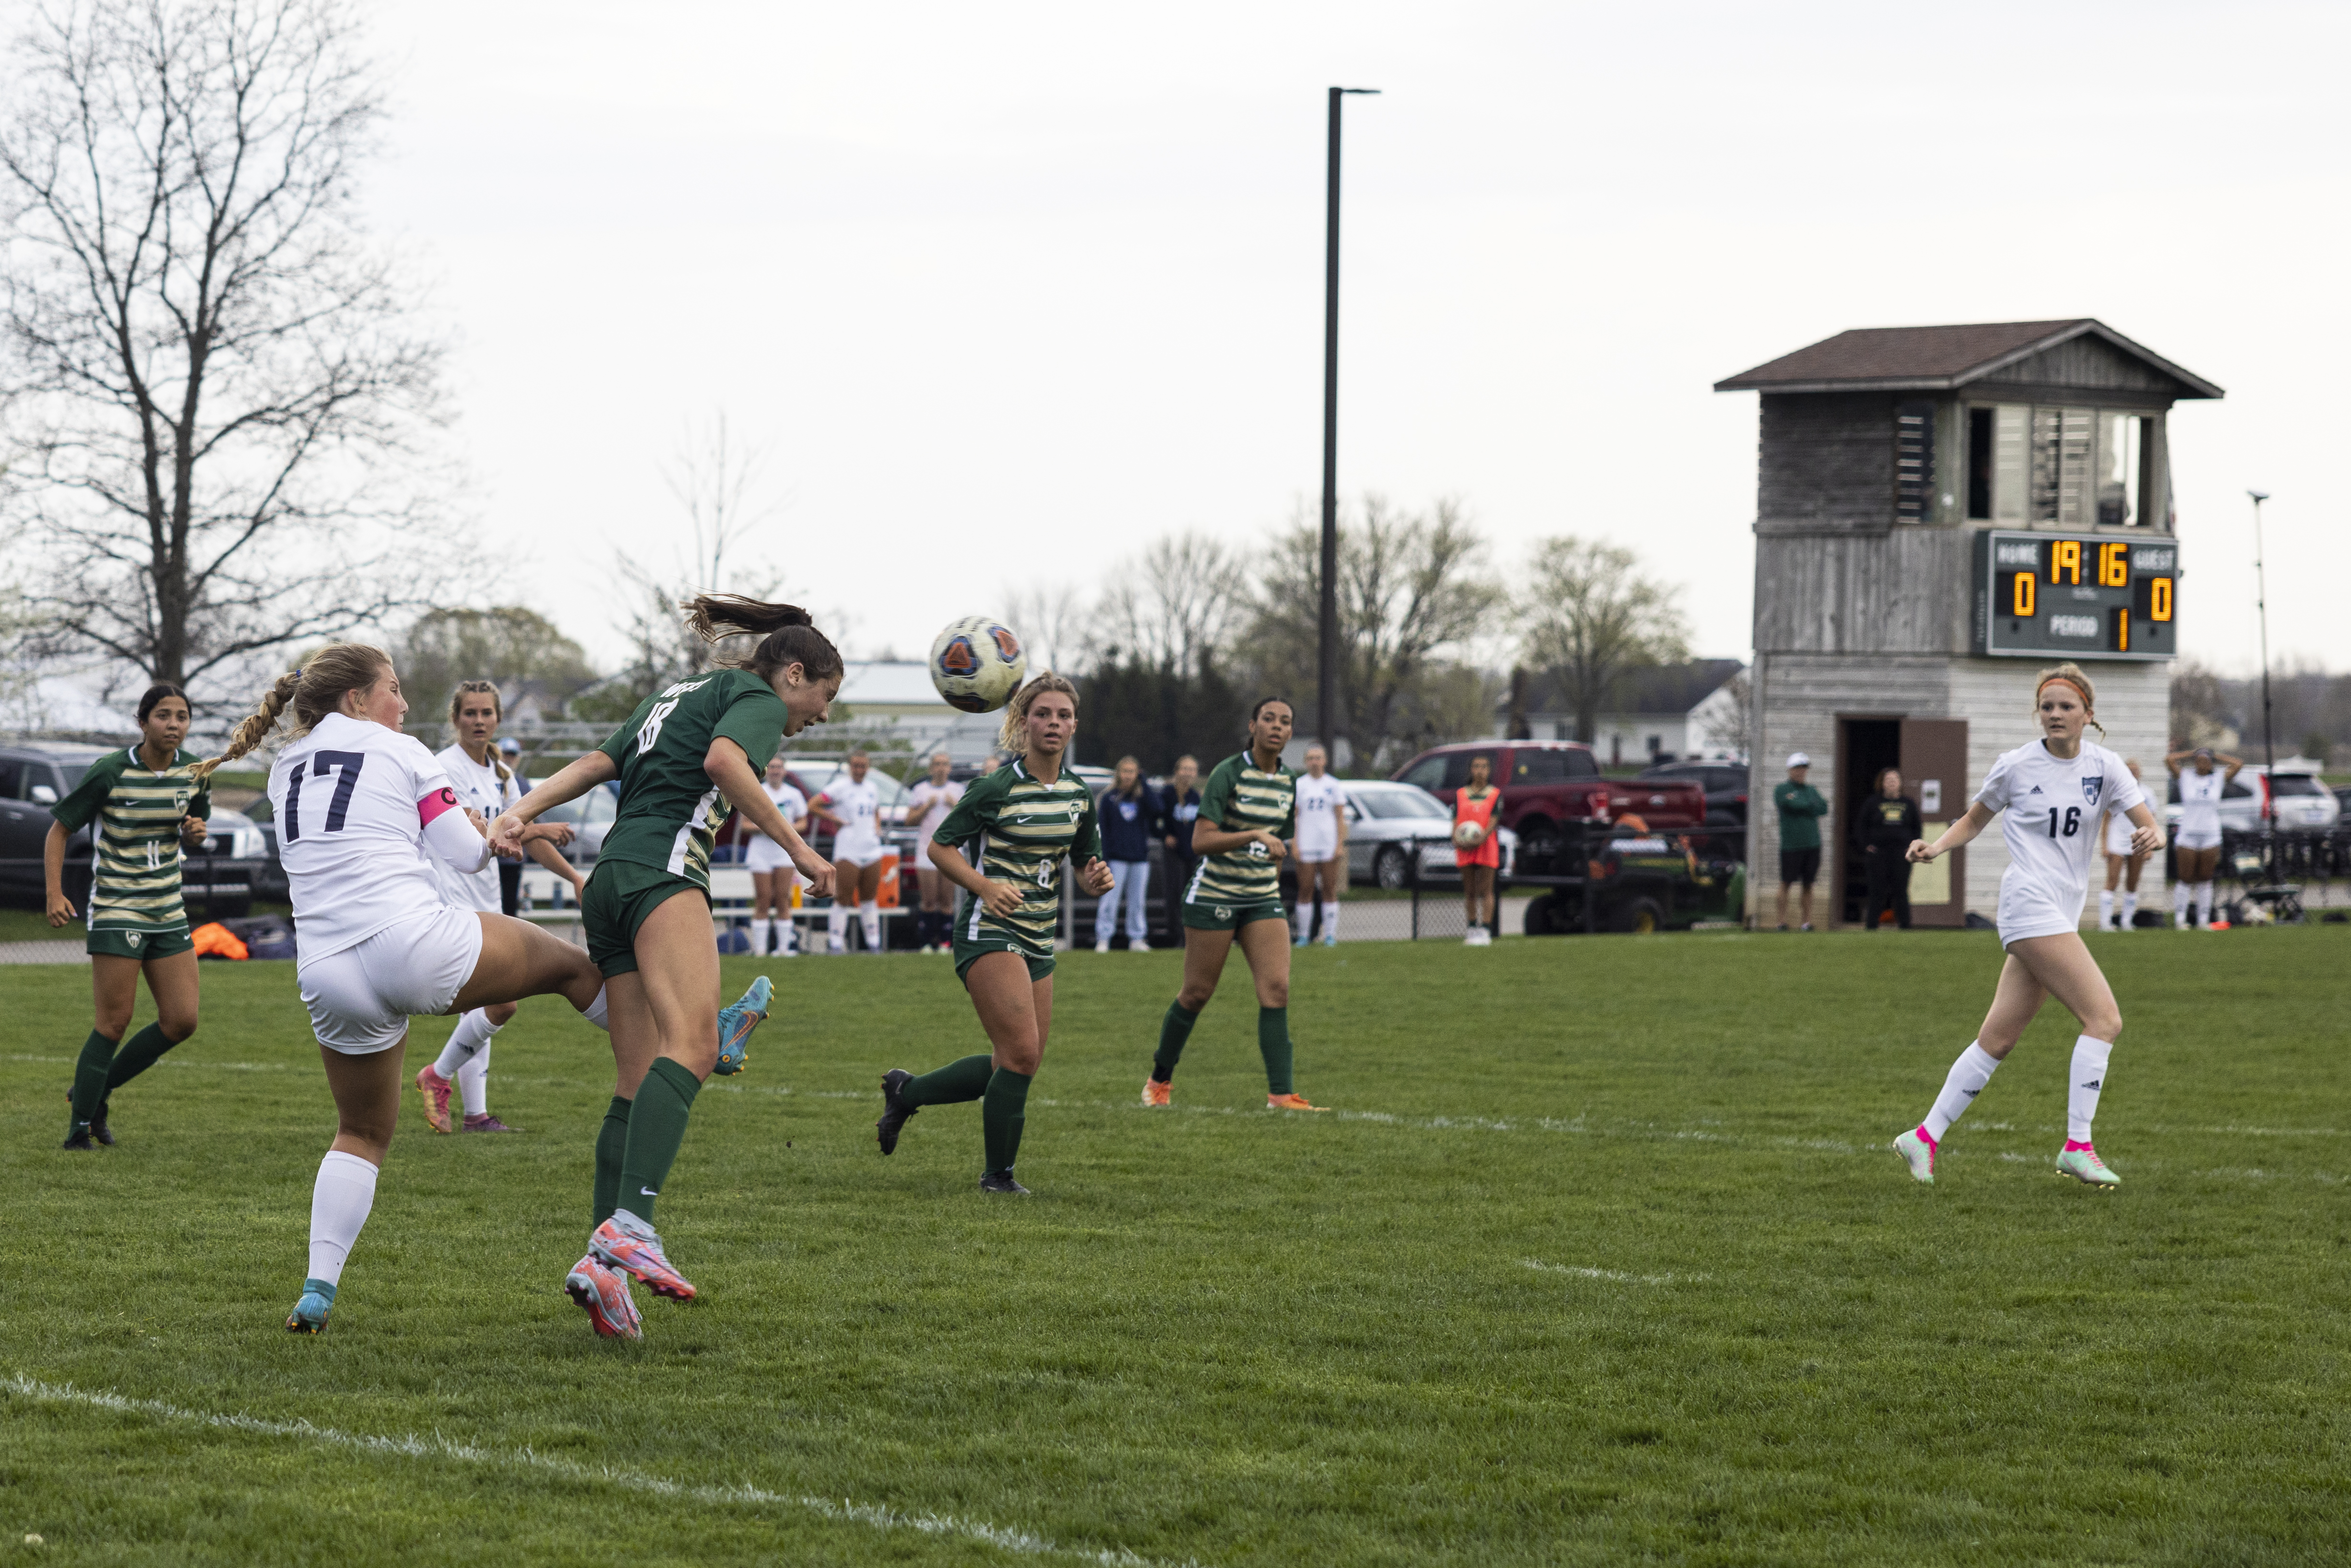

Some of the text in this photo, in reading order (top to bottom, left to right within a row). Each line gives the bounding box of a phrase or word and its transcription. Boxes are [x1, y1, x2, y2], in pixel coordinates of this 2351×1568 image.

[2051, 540, 2127, 586] 19 16
[2014, 572, 2035, 616] 0
[2151, 578, 2172, 621] 0
[2050, 615, 2098, 637] PERIOD
[2118, 608, 2128, 652] 1
[634, 698, 679, 758] 18
[285, 750, 365, 843] 17
[441, 788, 457, 805] C
[2049, 807, 2081, 838] 16
[147, 840, 161, 871] 11
[1037, 859, 1051, 888] 8
